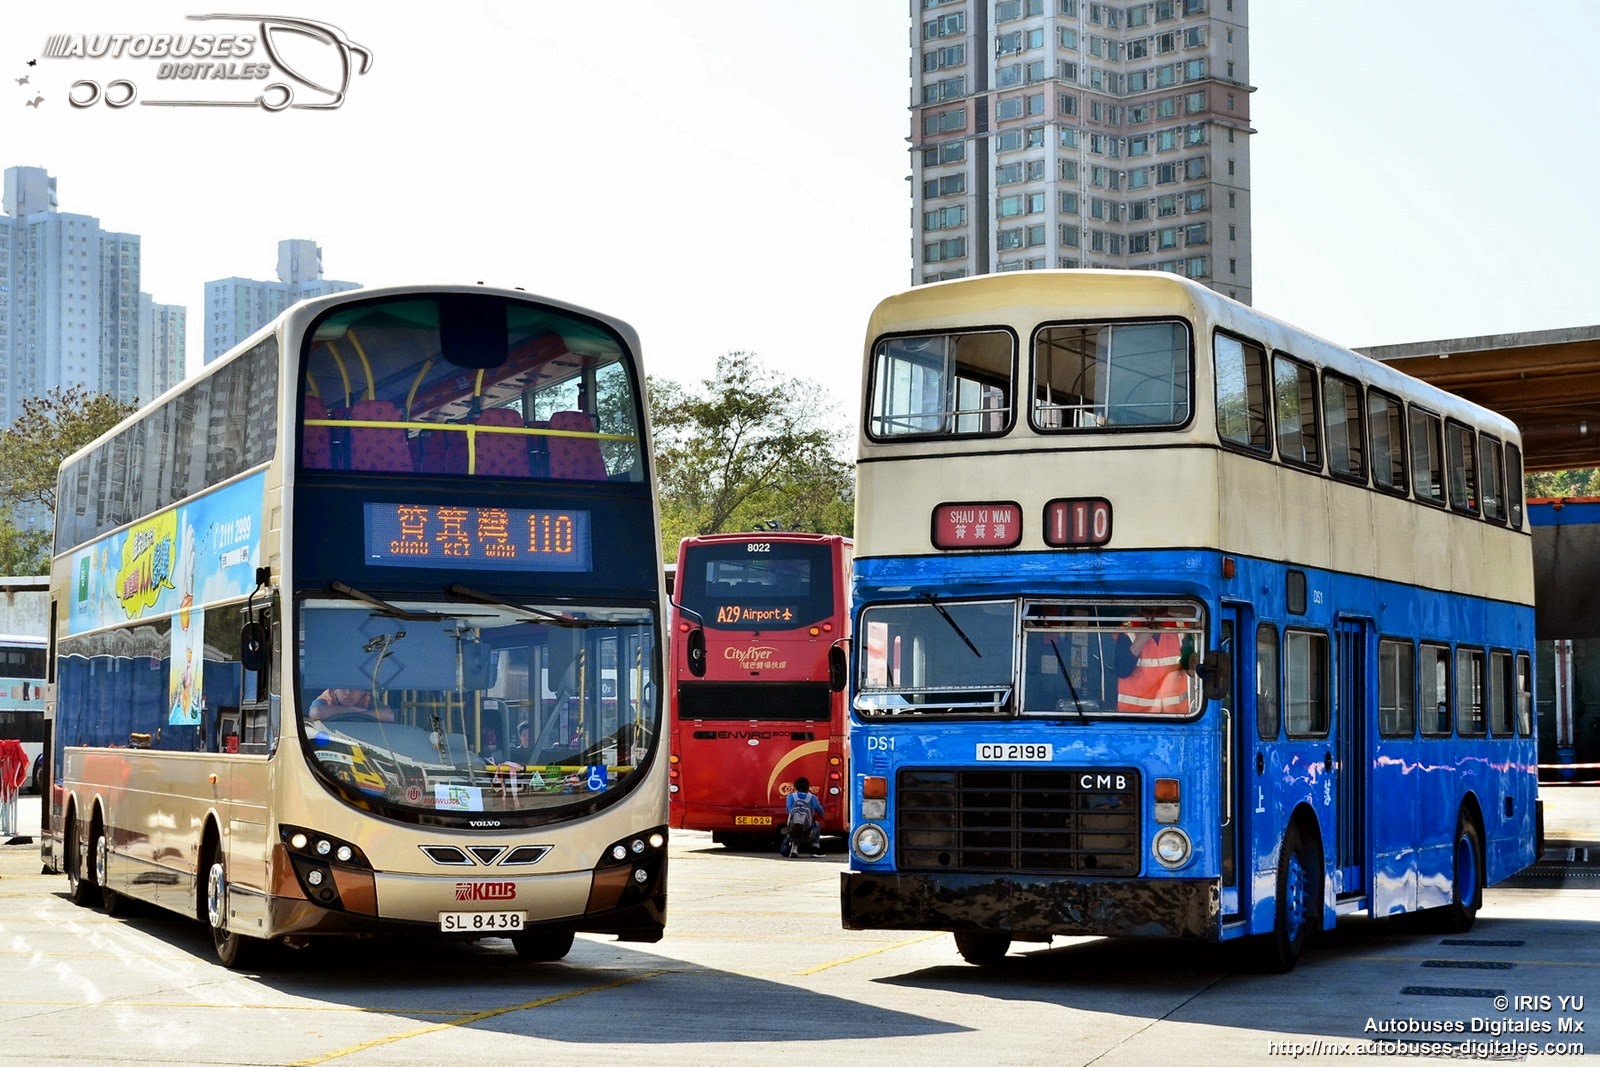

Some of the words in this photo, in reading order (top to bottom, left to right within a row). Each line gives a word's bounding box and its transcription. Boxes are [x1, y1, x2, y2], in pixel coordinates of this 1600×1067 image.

[950, 510, 975, 523] SHAU
[978, 510, 988, 523] KI
[992, 510, 1011, 523] WAN
[1056, 507, 1108, 539] 110
[219, 520, 234, 548] 2111
[527, 514, 573, 553] 110
[747, 543, 770, 552] 8022
[1313, 590, 1324, 604] DS1
[717, 606, 741, 623] A29
[742, 608, 781, 622] Airport
[724, 646, 773, 662] Cityflyer
[867, 736, 896, 750] DS1
[981, 745, 1003, 759] CD
[1008, 745, 1047, 759] 2198
[1080, 774, 1127, 790] CMB
[469, 820, 501, 828] VOLVO
[736, 816, 748, 825] SE
[750, 816, 771, 825] 1629
[472, 882, 517, 901] KMB
[445, 914, 468, 930] SL
[472, 913, 521, 929] 8438
